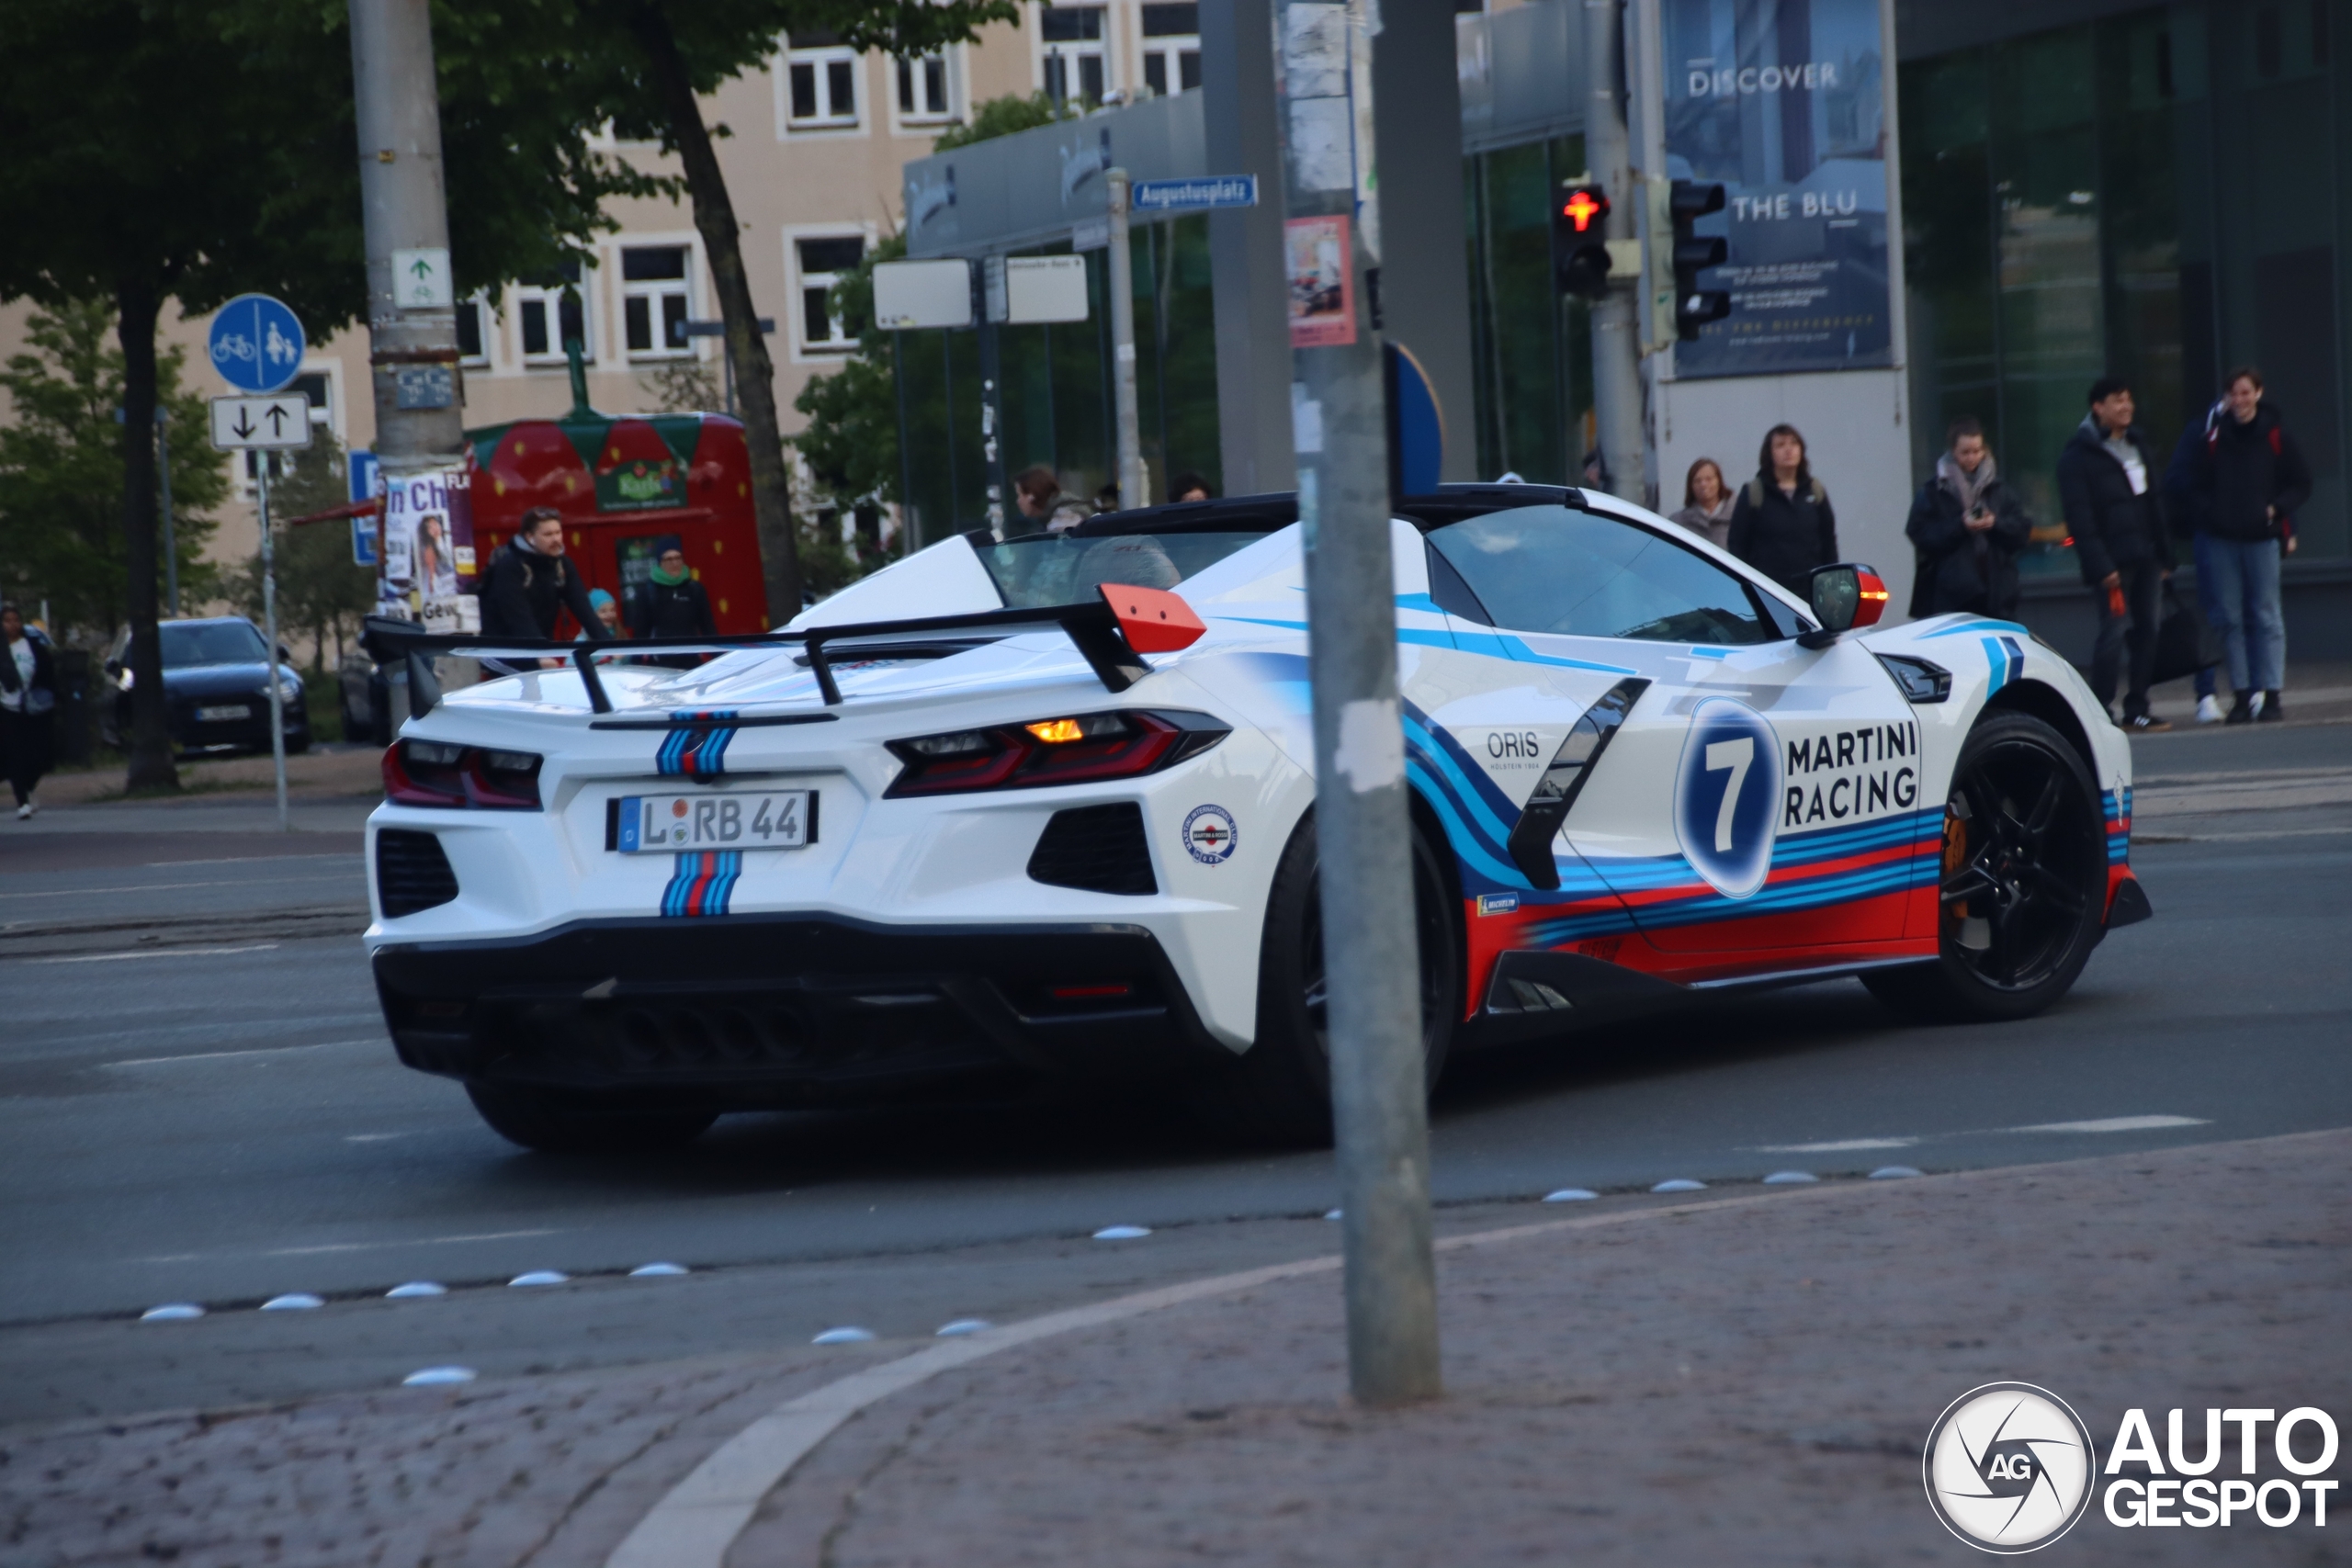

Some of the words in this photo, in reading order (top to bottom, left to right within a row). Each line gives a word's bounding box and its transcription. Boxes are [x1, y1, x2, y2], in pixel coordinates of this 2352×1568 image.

[1689, 62, 1838, 97] DISCOVER
[1141, 179, 1245, 208] Augustusplatz
[1733, 193, 1791, 222] THE
[1803, 189, 1857, 218] BLU
[1487, 730, 1539, 759] ORIS
[1787, 720, 1917, 776] MARTINI
[1705, 736, 1754, 853] 7
[1785, 766, 1917, 828] RACING
[625, 829, 635, 842] D
[644, 802, 667, 844] L
[694, 798, 742, 842] RB
[751, 796, 797, 840] 44
[1183, 817, 1193, 851] MARTINI
[1190, 806, 1231, 823] INTERNATIONAL
[1229, 821, 1238, 846] CLUB
[1488, 898, 1516, 909] MICHELIN
